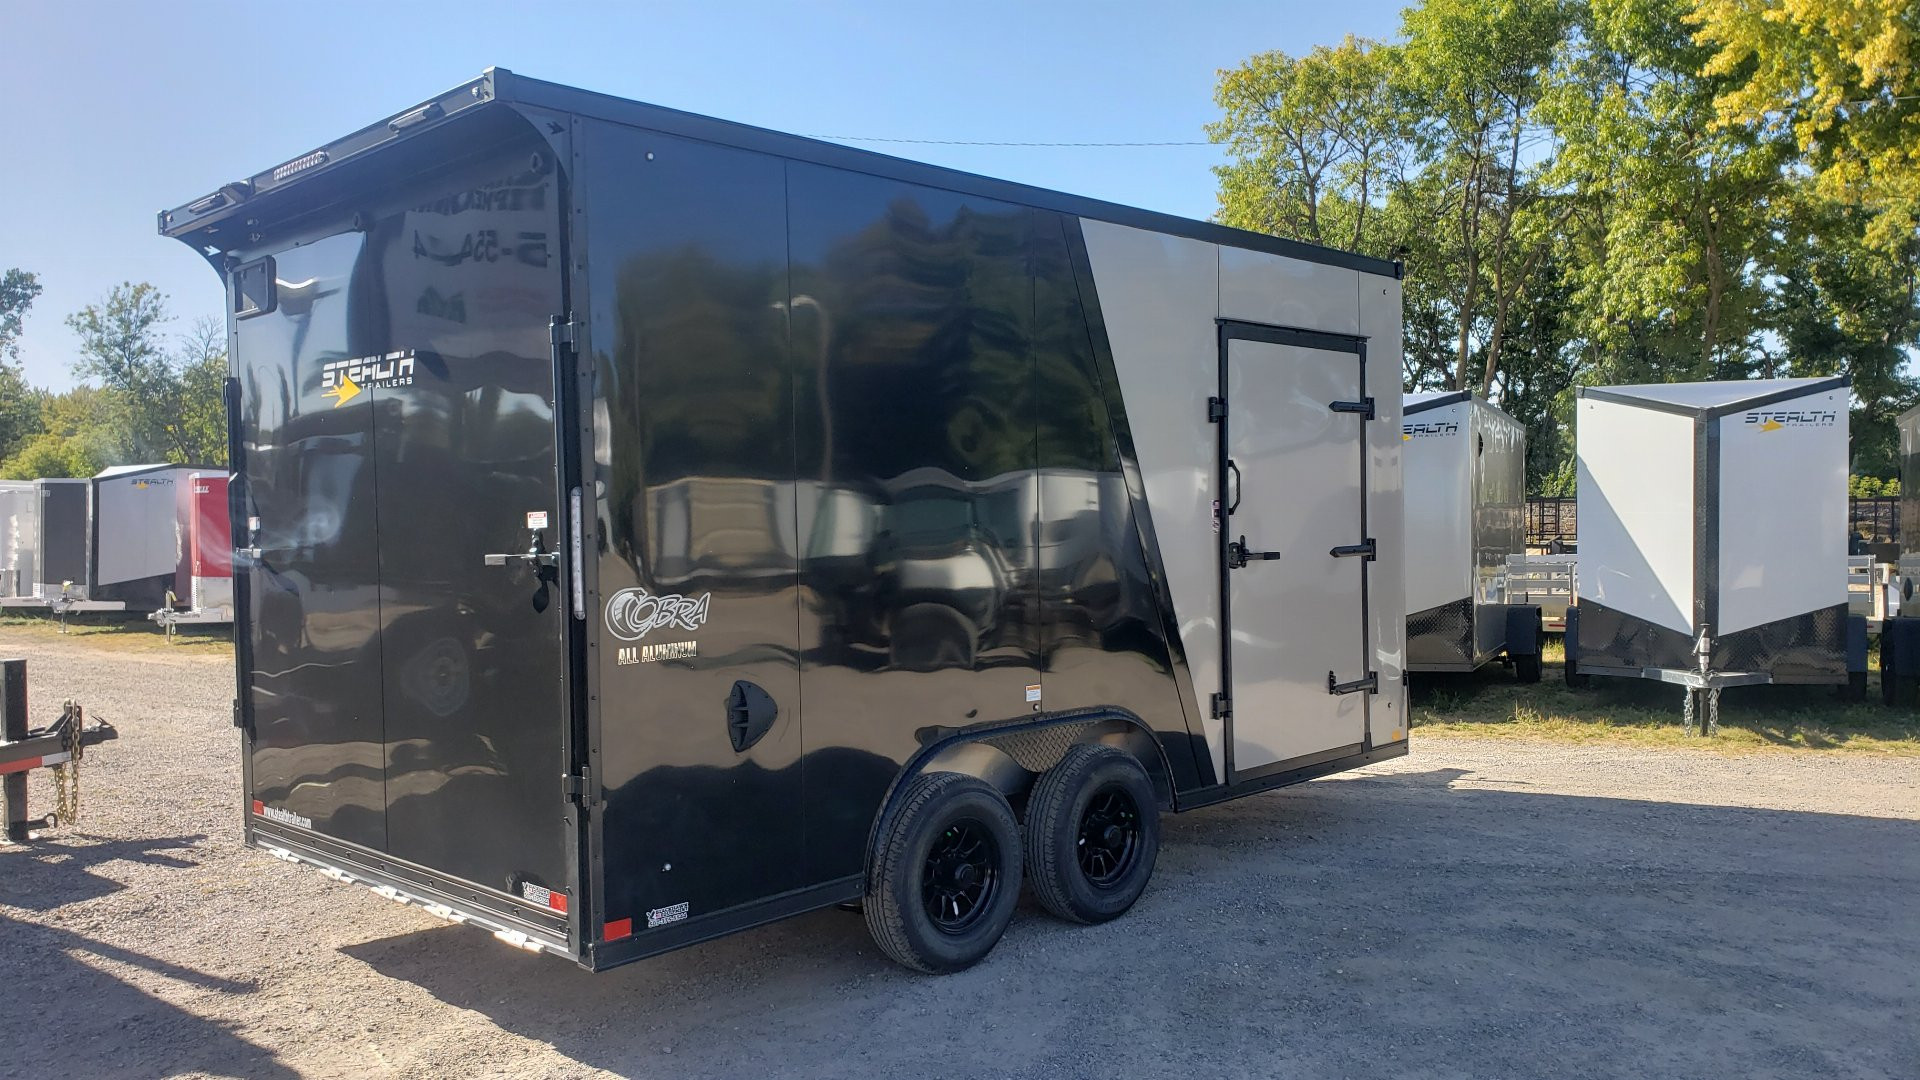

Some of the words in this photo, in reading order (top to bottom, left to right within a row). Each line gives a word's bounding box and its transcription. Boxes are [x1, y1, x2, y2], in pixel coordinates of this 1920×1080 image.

[322, 349, 415, 388] STEALTH
[361, 376, 413, 390] TRAILERS
[1745, 411, 1836, 424] STEALTH
[604, 587, 711, 641] COBRA
[617, 647, 639, 666] ALL
[641, 640, 697, 663] ALUMINUM
